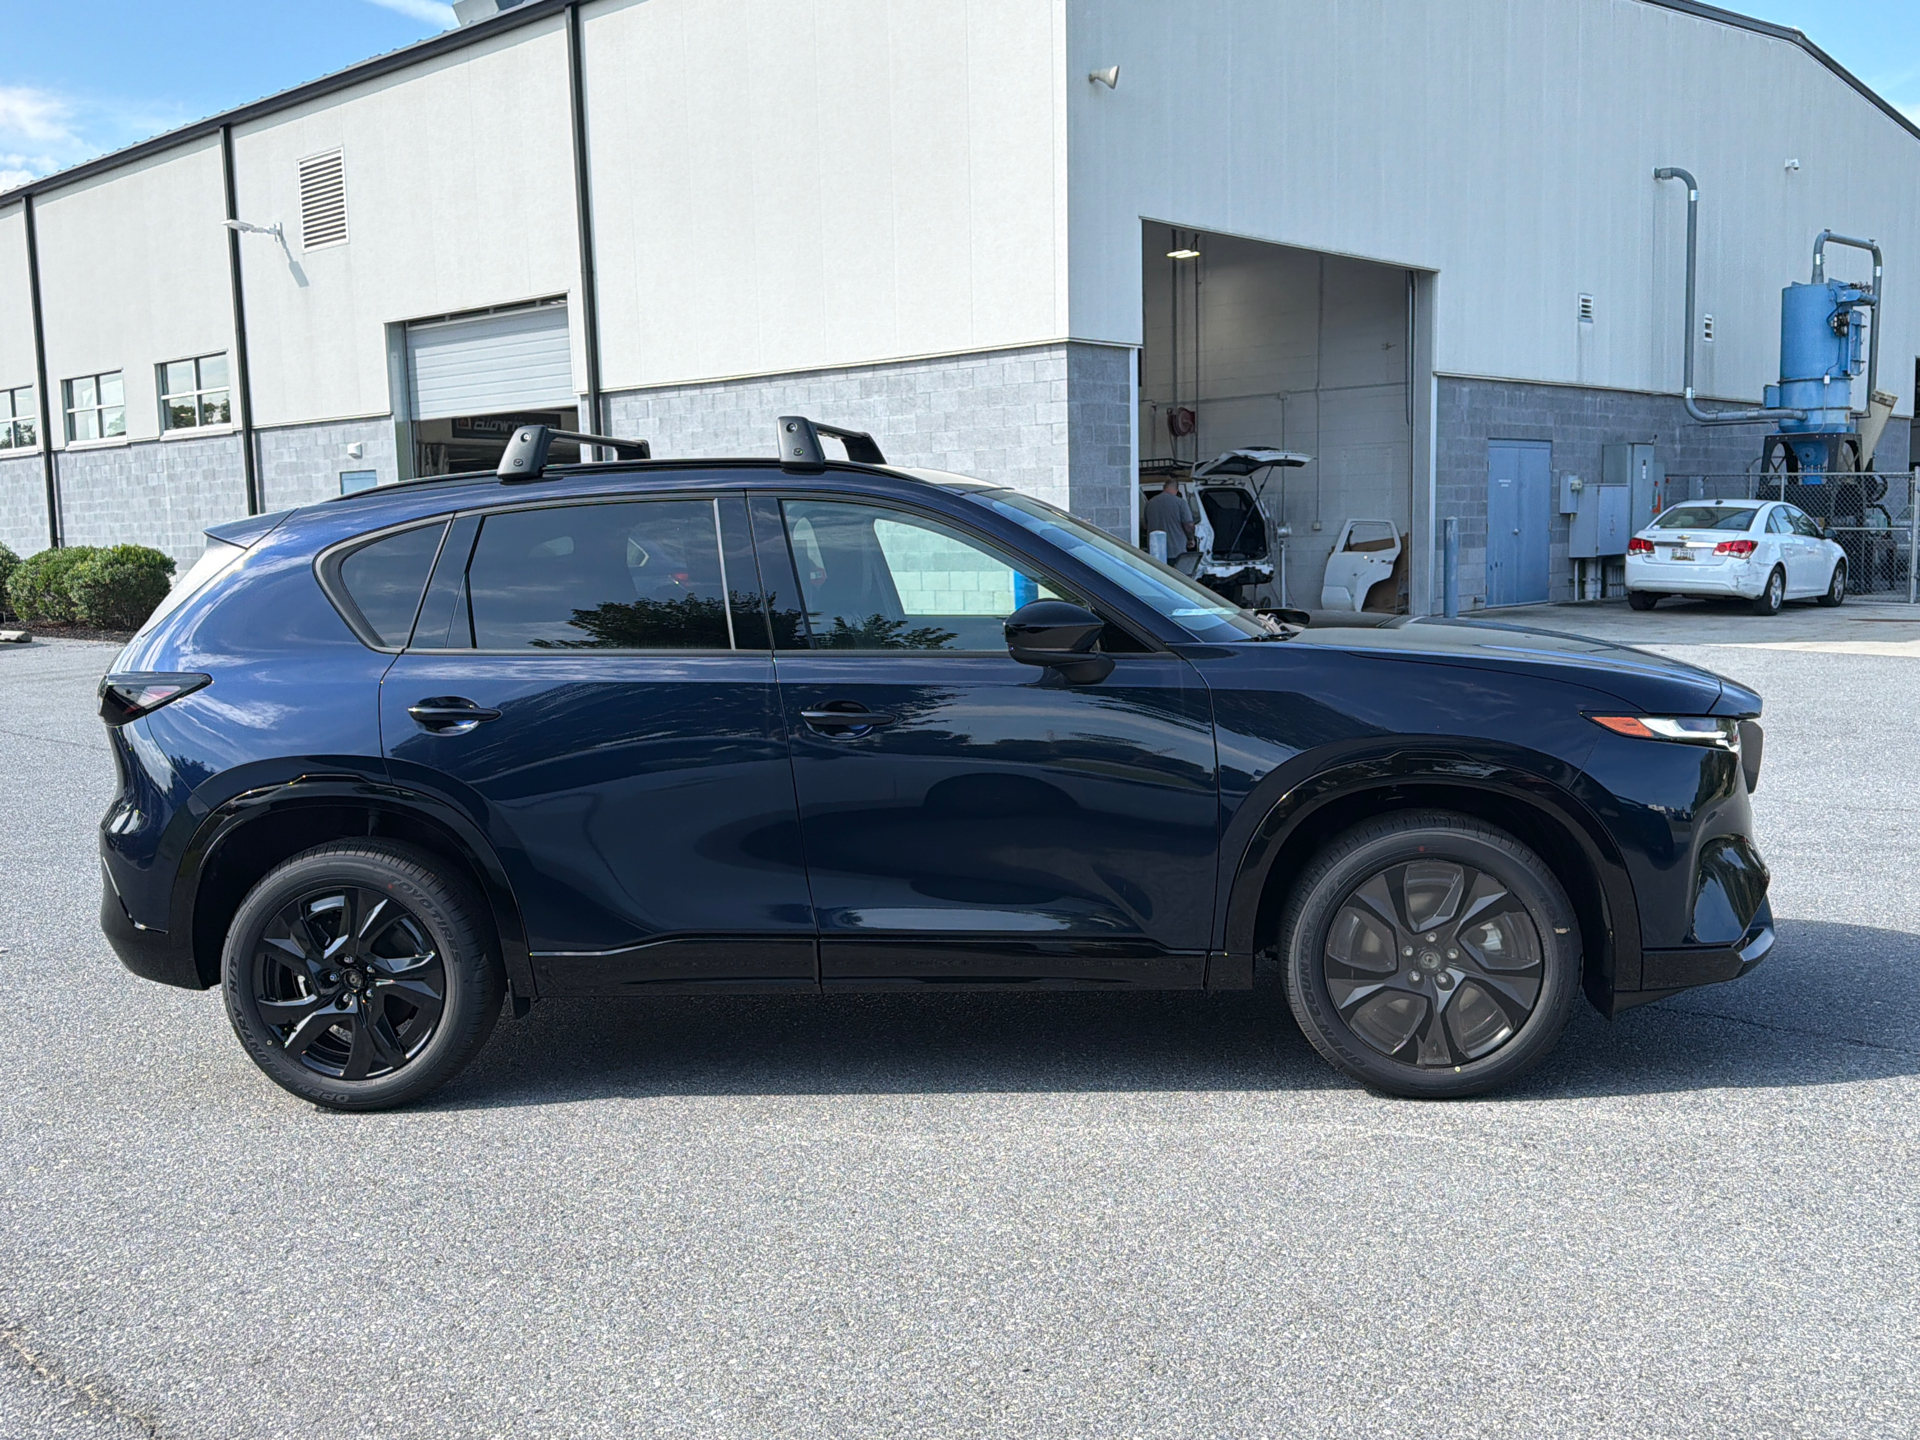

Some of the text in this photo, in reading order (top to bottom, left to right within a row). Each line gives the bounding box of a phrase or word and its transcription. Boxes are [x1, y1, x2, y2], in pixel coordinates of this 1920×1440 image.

[388, 875, 434, 910] TOYO
[432, 910, 463, 964] TIRES
[1299, 922, 1323, 1017] COUNTRY
[229, 956, 351, 1104] OPEN COUNTRY H/T
